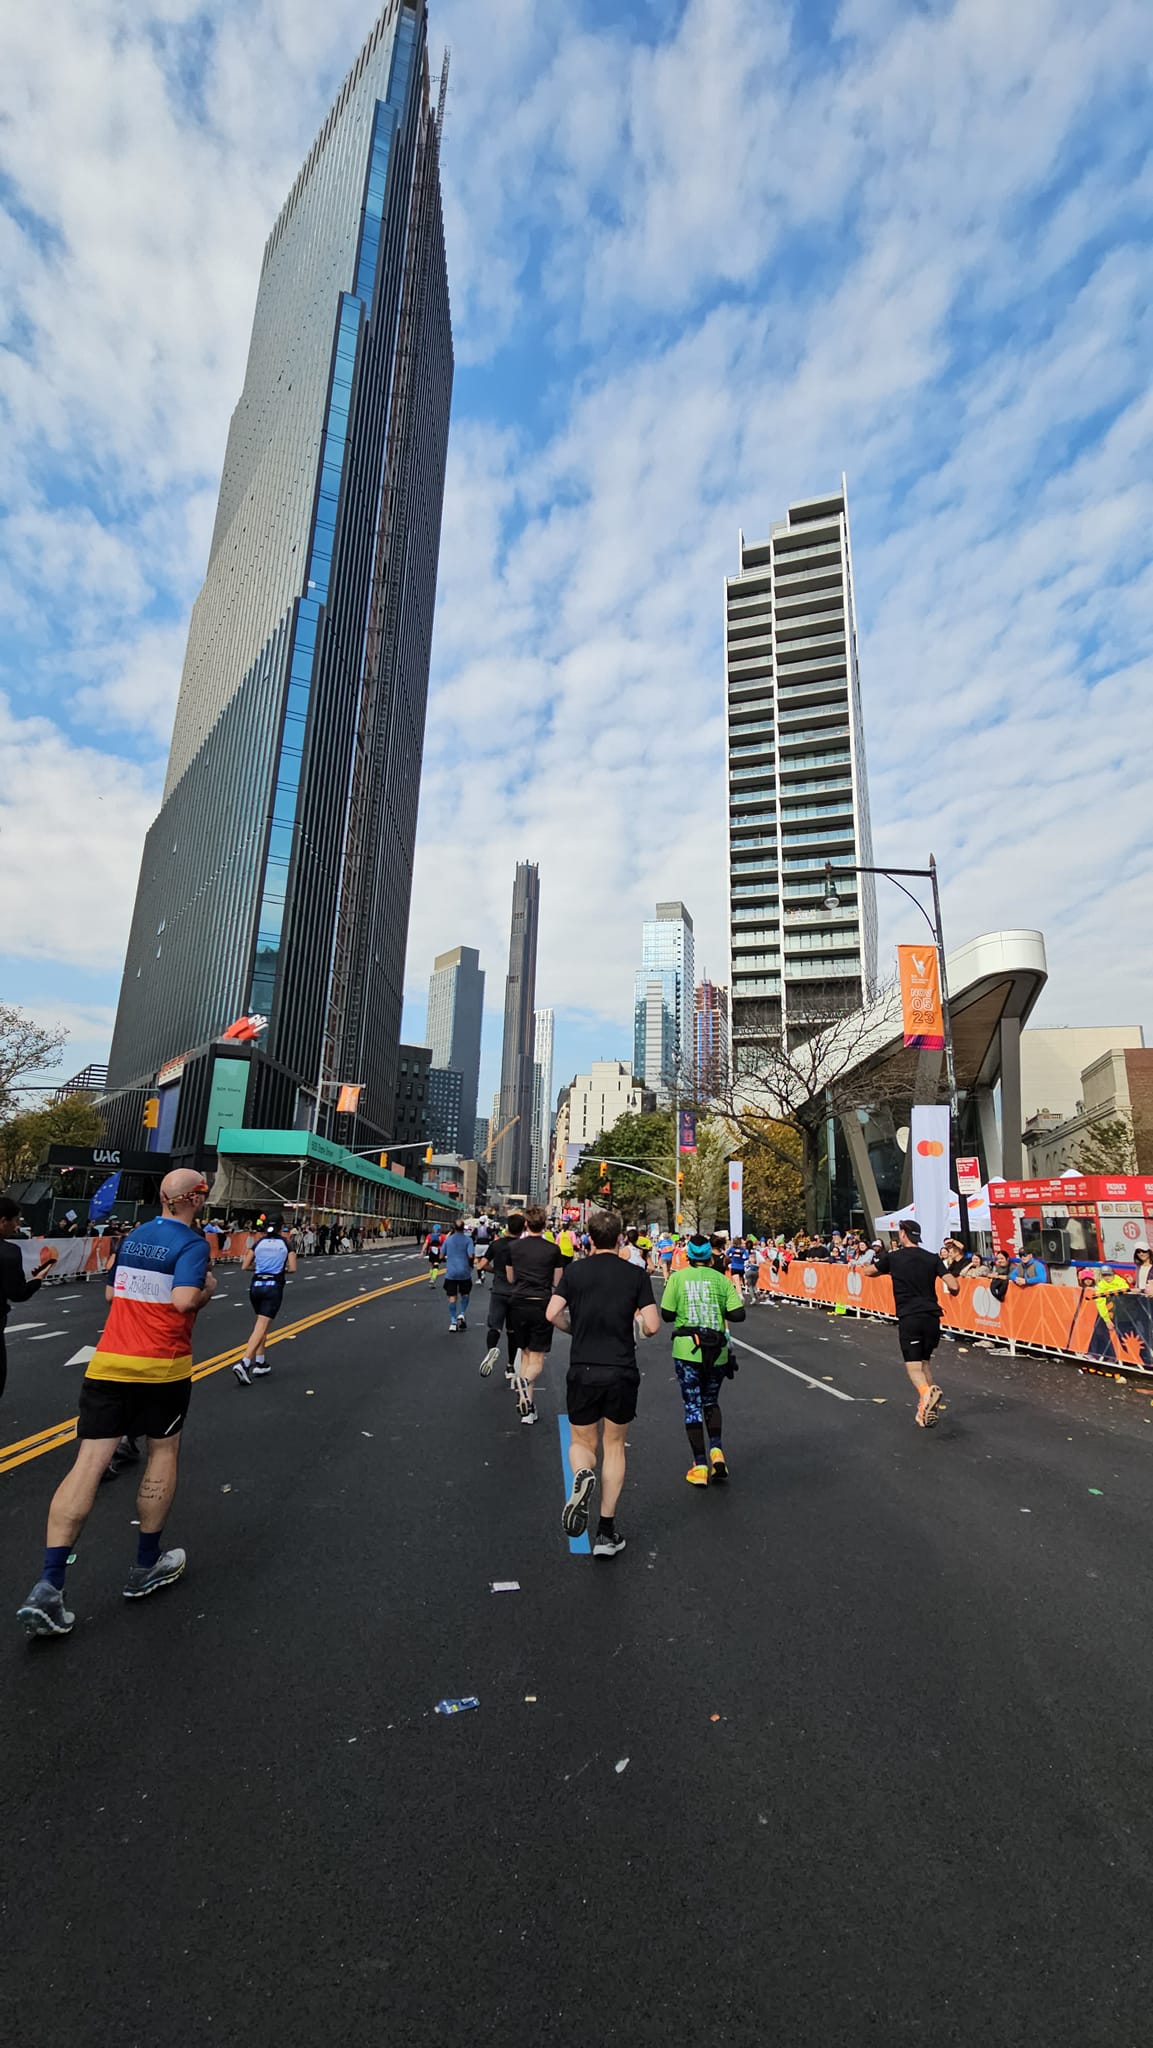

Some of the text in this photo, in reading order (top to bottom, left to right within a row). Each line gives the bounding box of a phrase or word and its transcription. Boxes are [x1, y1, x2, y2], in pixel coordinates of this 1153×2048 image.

[911, 988, 933, 997] NOV
[912, 997, 934, 1010] 05
[912, 1010, 935, 1024] 23
[93, 1149, 121, 1163] UAG
[122, 1240, 170, 1261] ELASQUEZ
[685, 1280, 711, 1301] WE
